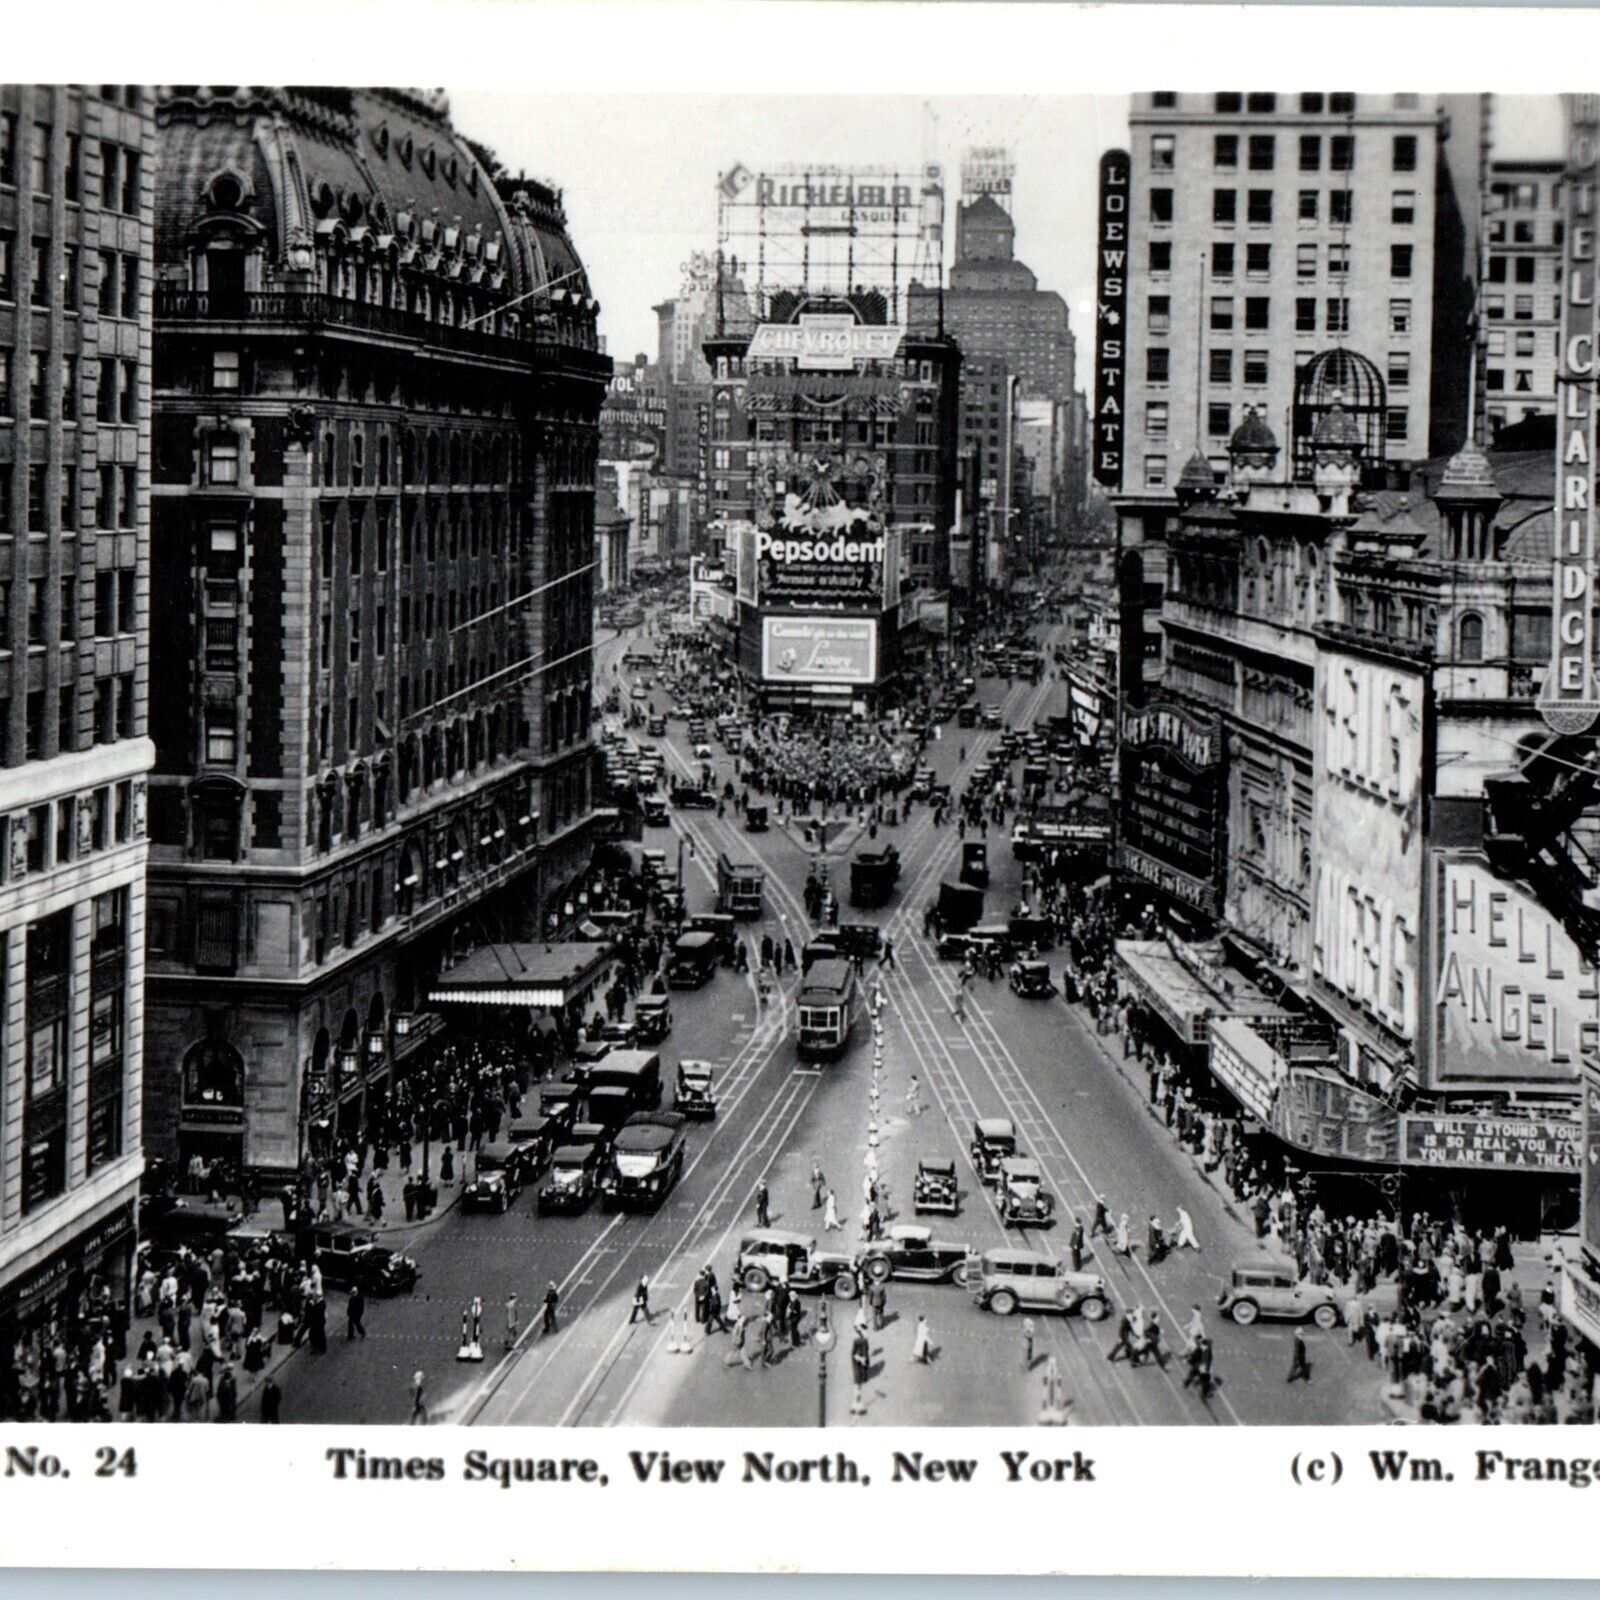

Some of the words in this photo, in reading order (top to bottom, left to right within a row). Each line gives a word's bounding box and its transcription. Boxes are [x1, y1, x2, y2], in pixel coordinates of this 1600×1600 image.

[760, 329, 894, 350] CHEVROLET
[1100, 340, 1121, 471] STATE
[1560, 334, 1593, 691] CLARIDGE
[755, 531, 885, 564] Pepsodent
[1433, 1120, 1466, 1135] WILL
[1475, 1122, 1538, 1138] ASTOUND
[1424, 1134, 1437, 1147] IS
[1446, 1136, 1465, 1148] SO
[1419, 1147, 1446, 1162] YOU
[1456, 1150, 1484, 1163] ARE
[1493, 1151, 1507, 1164] IN
[1515, 1151, 1526, 1165] A
